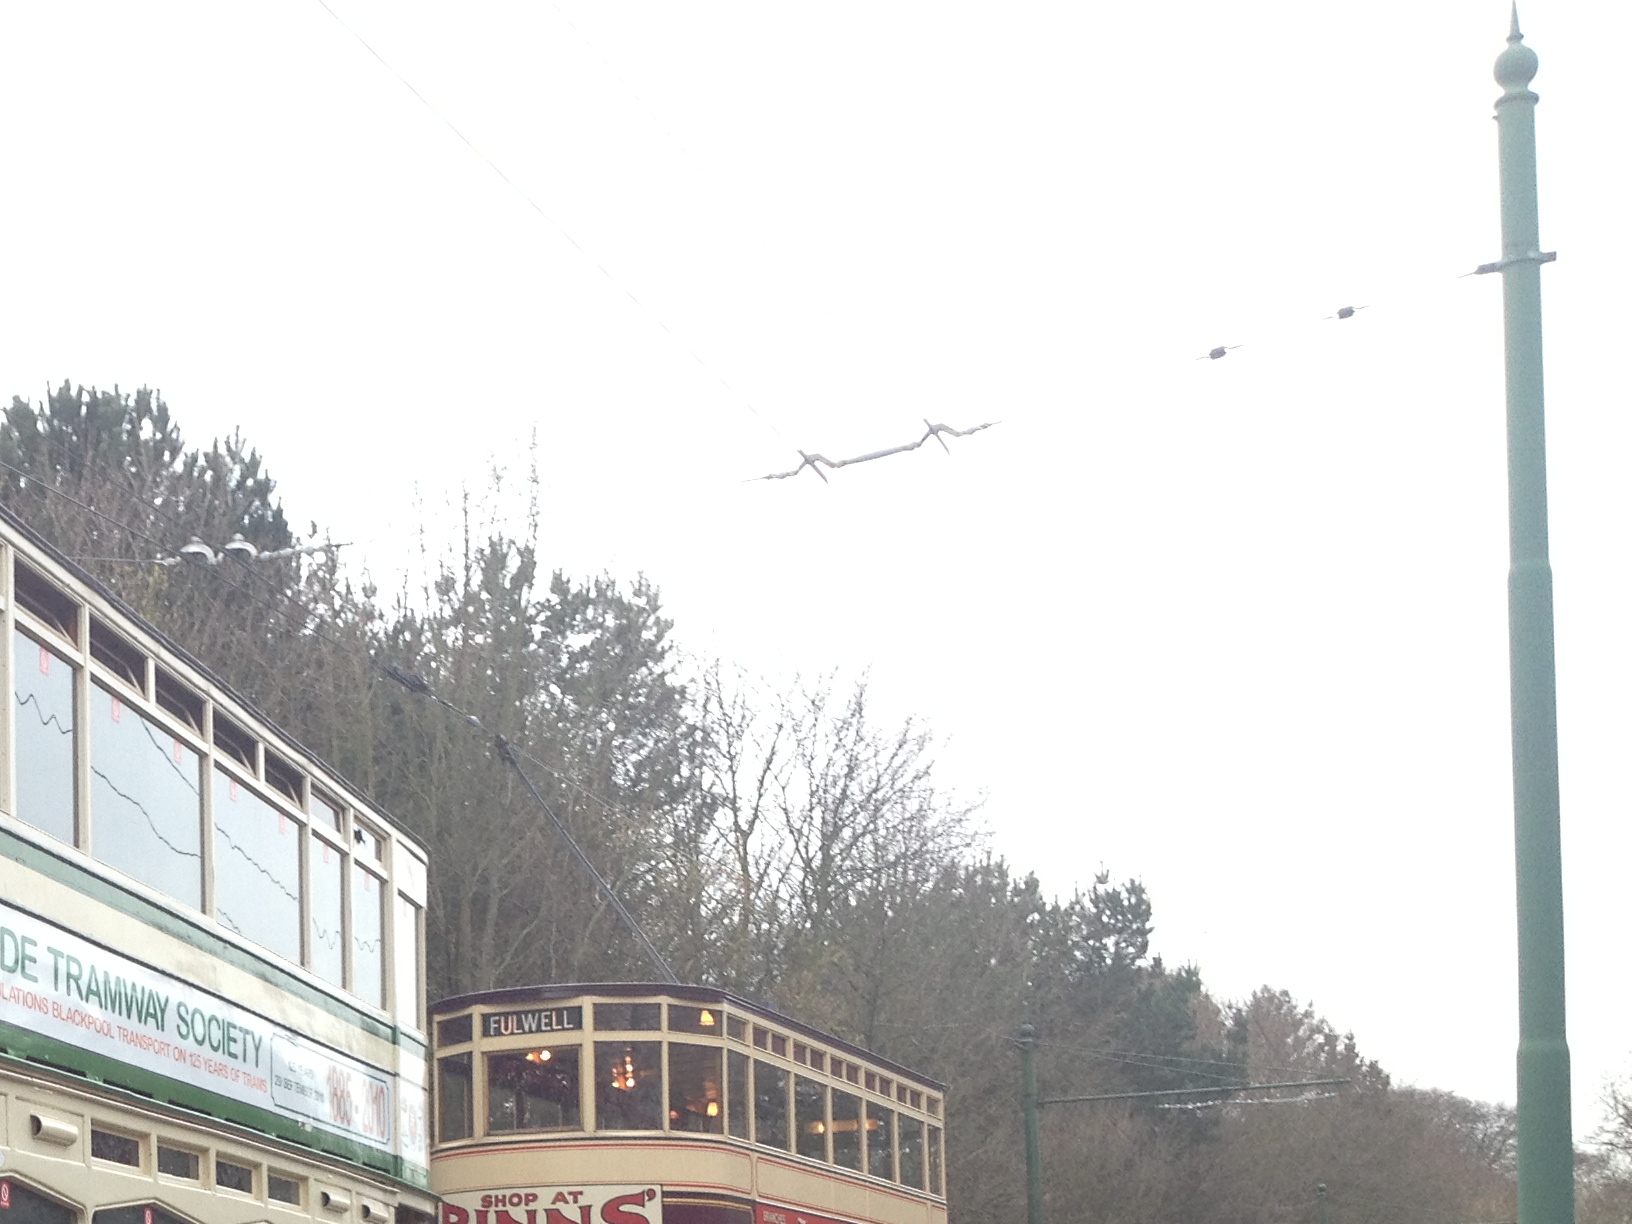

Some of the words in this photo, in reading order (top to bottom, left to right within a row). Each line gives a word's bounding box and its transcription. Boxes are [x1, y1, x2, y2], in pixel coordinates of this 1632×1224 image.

[46, 945, 169, 1032] TRAMWAY
[176, 1001, 263, 1068] SOCIETY
[489, 1010, 574, 1035] FULWELL
[52, 1001, 115, 1039] BLACKPOOL
[117, 1025, 171, 1058] TRANSPORT
[172, 1046, 186, 1064] ON
[189, 1053, 202, 1069] 125
[203, 1056, 229, 1079] YEARS
[230, 1067, 240, 1082] OF
[241, 1071, 267, 1093] TRAMS
[480, 1192, 539, 1209] SHOP
[551, 1190, 584, 1205] AT
